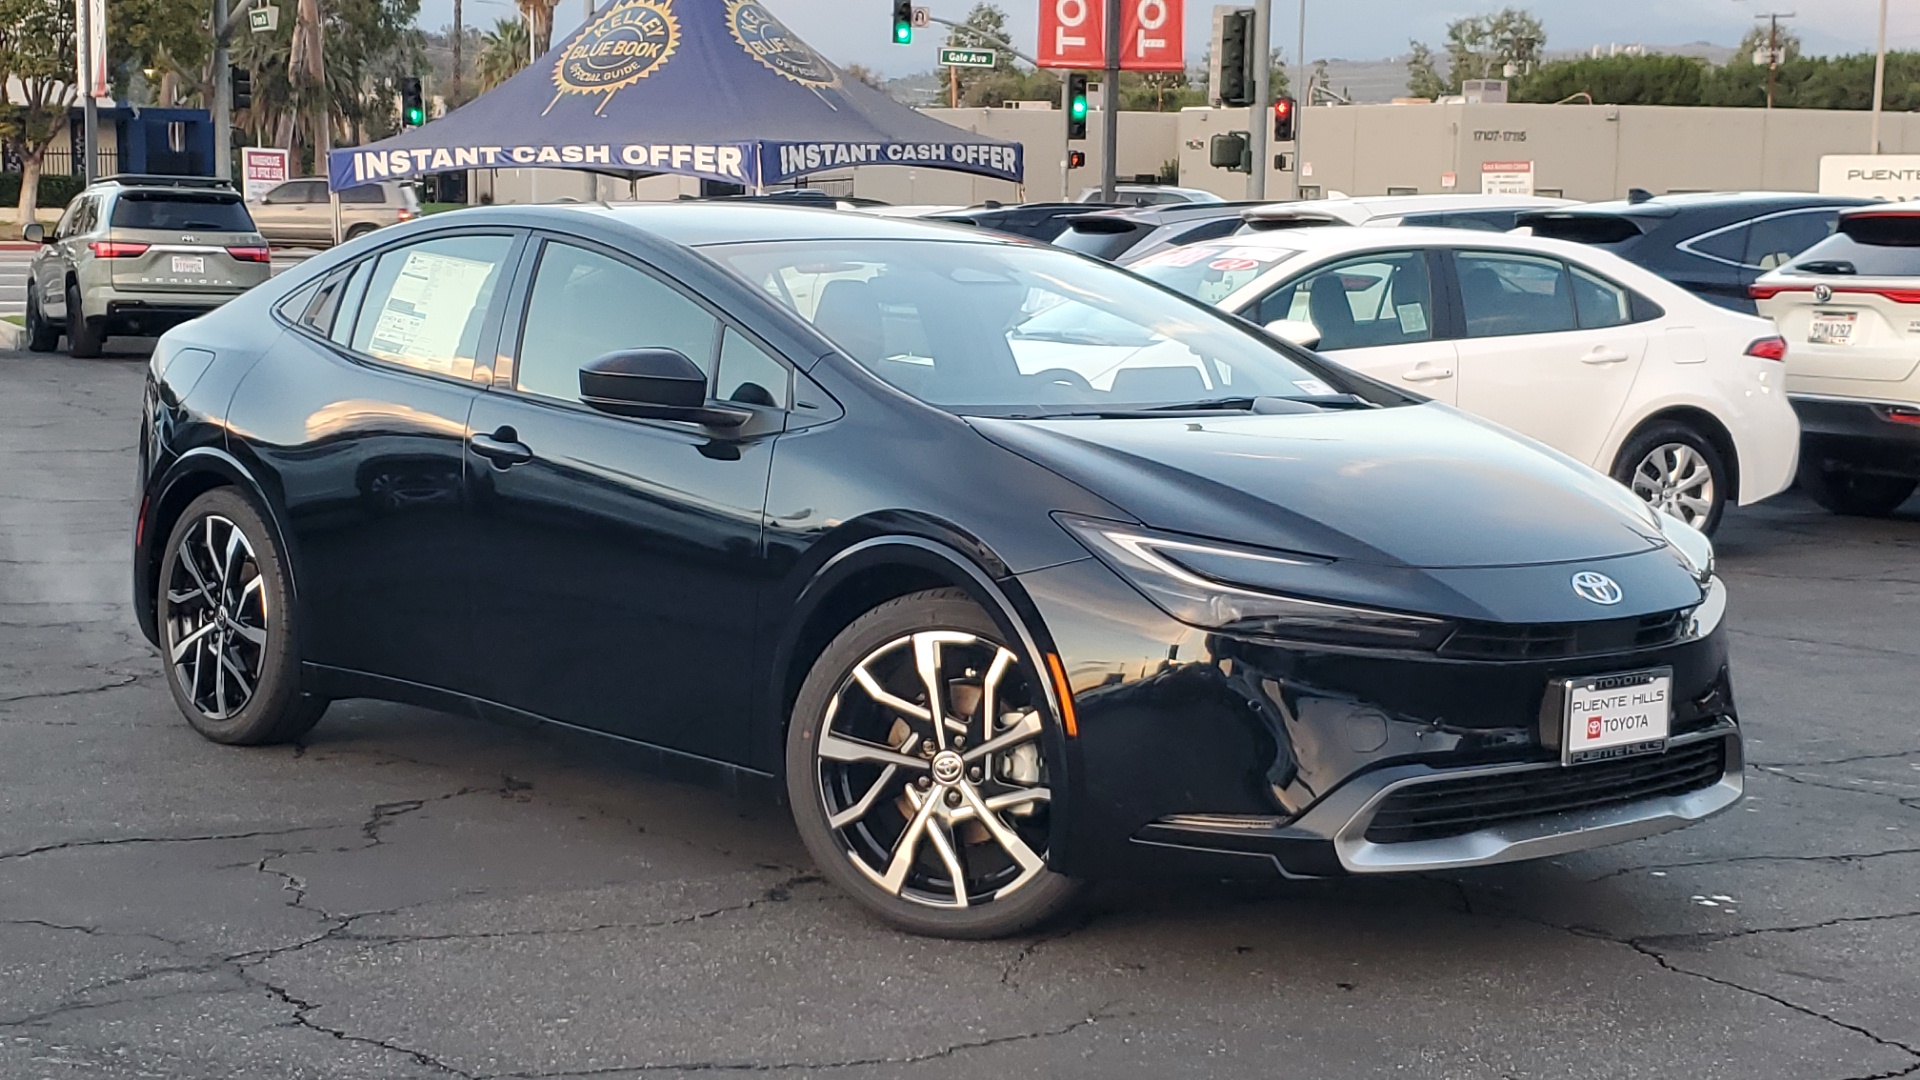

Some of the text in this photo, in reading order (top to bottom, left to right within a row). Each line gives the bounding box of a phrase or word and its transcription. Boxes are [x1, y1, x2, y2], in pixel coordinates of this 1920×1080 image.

[593, 10, 665, 38] KELLEY
[568, 40, 663, 60] BLUE BOOK
[948, 52, 987, 63] Gale Ave
[603, 61, 641, 81] GUIDE
[354, 145, 742, 182] INSTANT CASH OFFER
[780, 144, 1016, 175] INSTANT CASH OFFER
[1597, 673, 1650, 688] TOYOTA
[1572, 690, 1664, 714] PUENTE HILLS
[1603, 714, 1648, 733] TOYOTA
[1573, 740, 1663, 763] PUENTE HILLS
